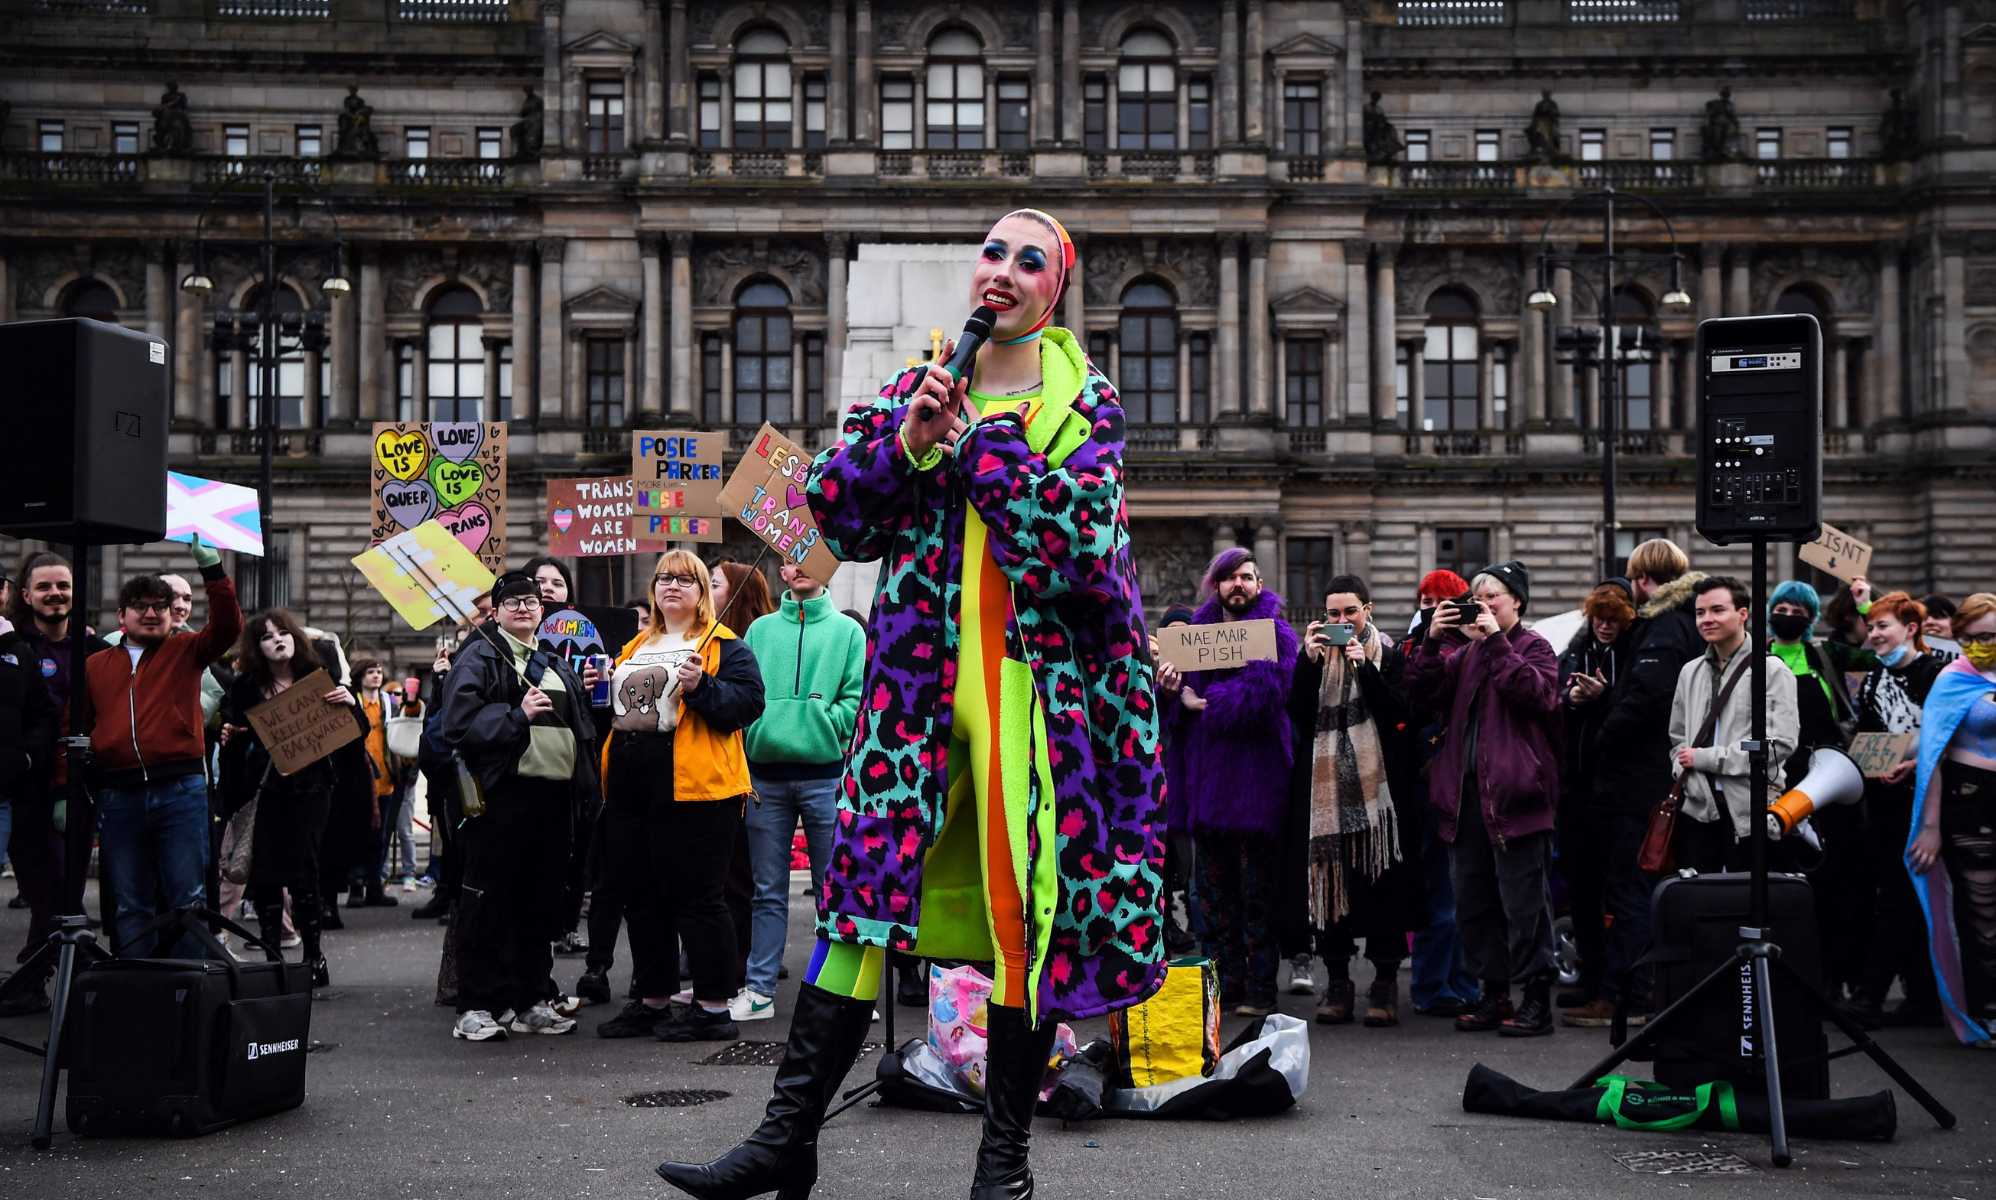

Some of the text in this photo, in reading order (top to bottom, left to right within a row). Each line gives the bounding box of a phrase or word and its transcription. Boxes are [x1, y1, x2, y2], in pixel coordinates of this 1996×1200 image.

[437, 429, 475, 446] LOVE
[640, 436, 697, 458] POSIE
[381, 440, 423, 459] LOVE
[756, 433, 809, 483] LESB
[393, 457, 411, 474] IS
[441, 468, 481, 482] LOVE
[656, 460, 721, 481] PARKER
[386, 490, 429, 508] QUEER
[446, 483, 462, 495] IS
[576, 479, 633, 500] TRANS
[638, 489, 686, 510] NOSIE
[577, 503, 633, 520] WOMEN
[753, 485, 820, 548] TRANS
[444, 513, 486, 537] RANS
[591, 520, 623, 536] ARE
[650, 514, 711, 536] PARKER
[740, 503, 809, 564] WOMEN
[579, 538, 637, 554] WOMEN
[543, 618, 597, 639] WOMEN
[1181, 627, 1249, 647] NAE MAIR
[1198, 645, 1243, 664] PISH
[259, 707, 286, 729] WE
[1739, 959, 1753, 1030] SENNHEIS
[259, 1038, 299, 1056] SENNHEISER
